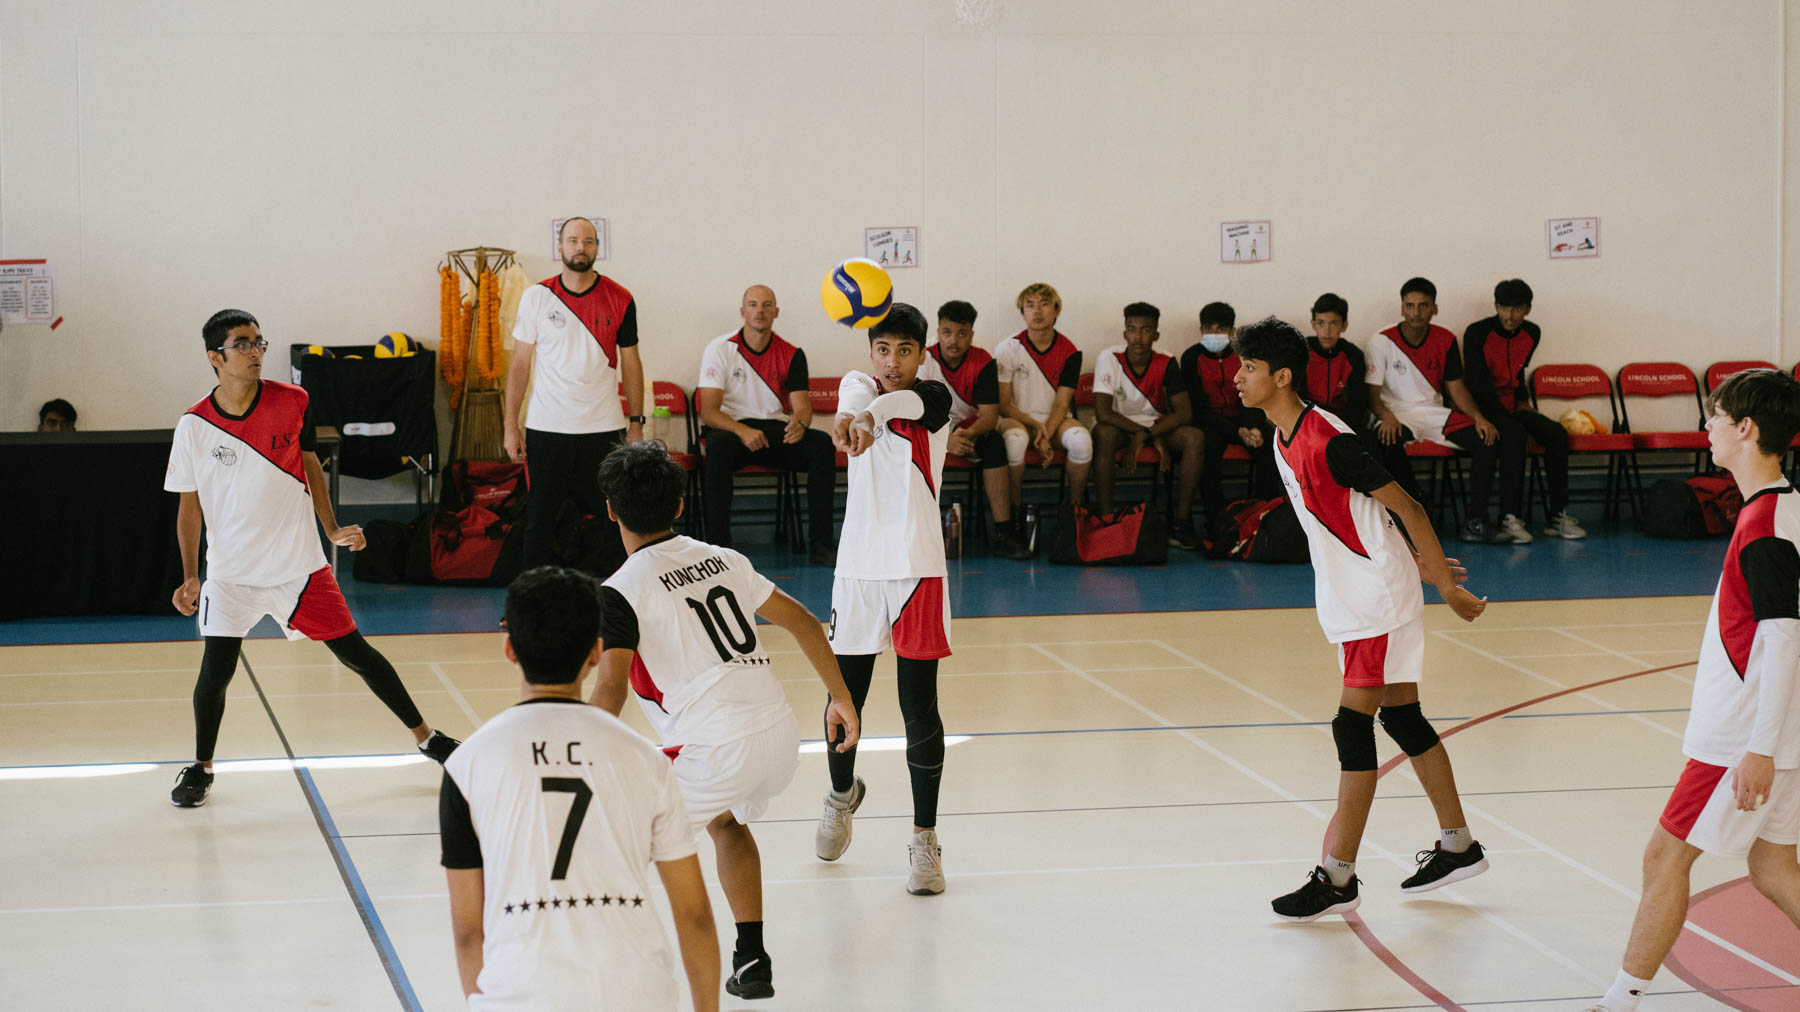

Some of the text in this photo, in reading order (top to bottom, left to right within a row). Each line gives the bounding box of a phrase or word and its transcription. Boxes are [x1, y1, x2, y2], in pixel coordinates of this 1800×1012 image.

[870, 231, 891, 241] SCISSOR
[873, 237, 893, 248] LUNGES
[1542, 375, 1600, 383] LINCOLN SCHOOL
[271, 433, 292, 450] LS
[659, 555, 730, 592] KUNCHOK
[685, 585, 757, 663] 10
[828, 608, 838, 642] 9
[541, 777, 593, 880] 7
